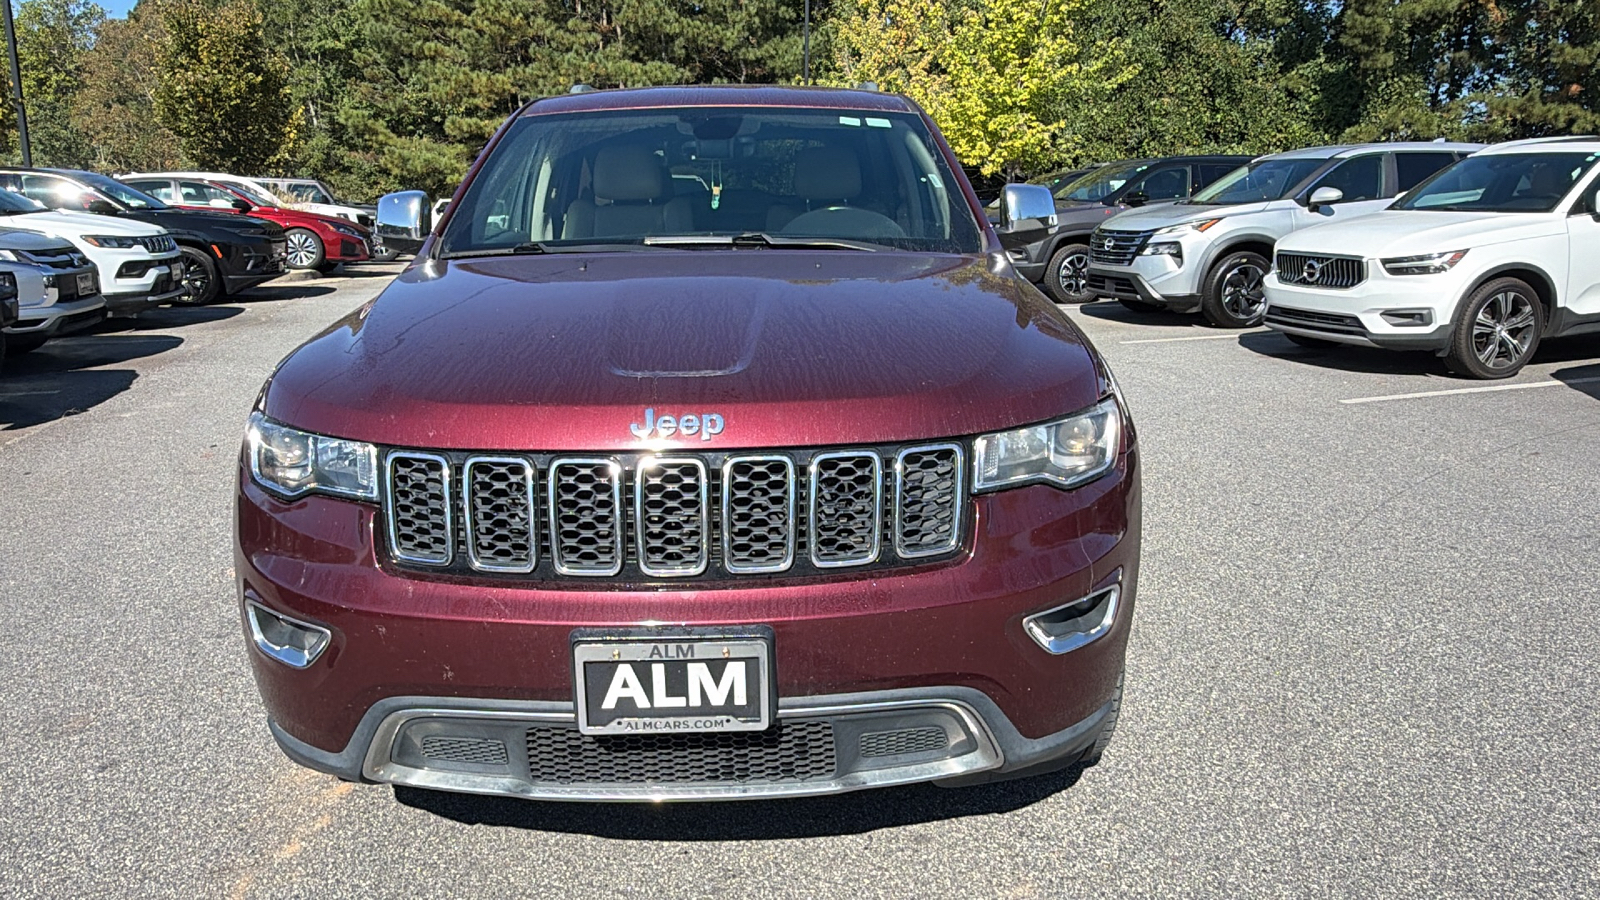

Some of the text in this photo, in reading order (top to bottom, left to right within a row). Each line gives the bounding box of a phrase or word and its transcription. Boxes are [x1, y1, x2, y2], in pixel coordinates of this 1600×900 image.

[629, 407, 725, 441] Jeep
[649, 644, 695, 659] ALM
[601, 661, 747, 709] ALM
[625, 719, 725, 731] ALMCARS.COM
